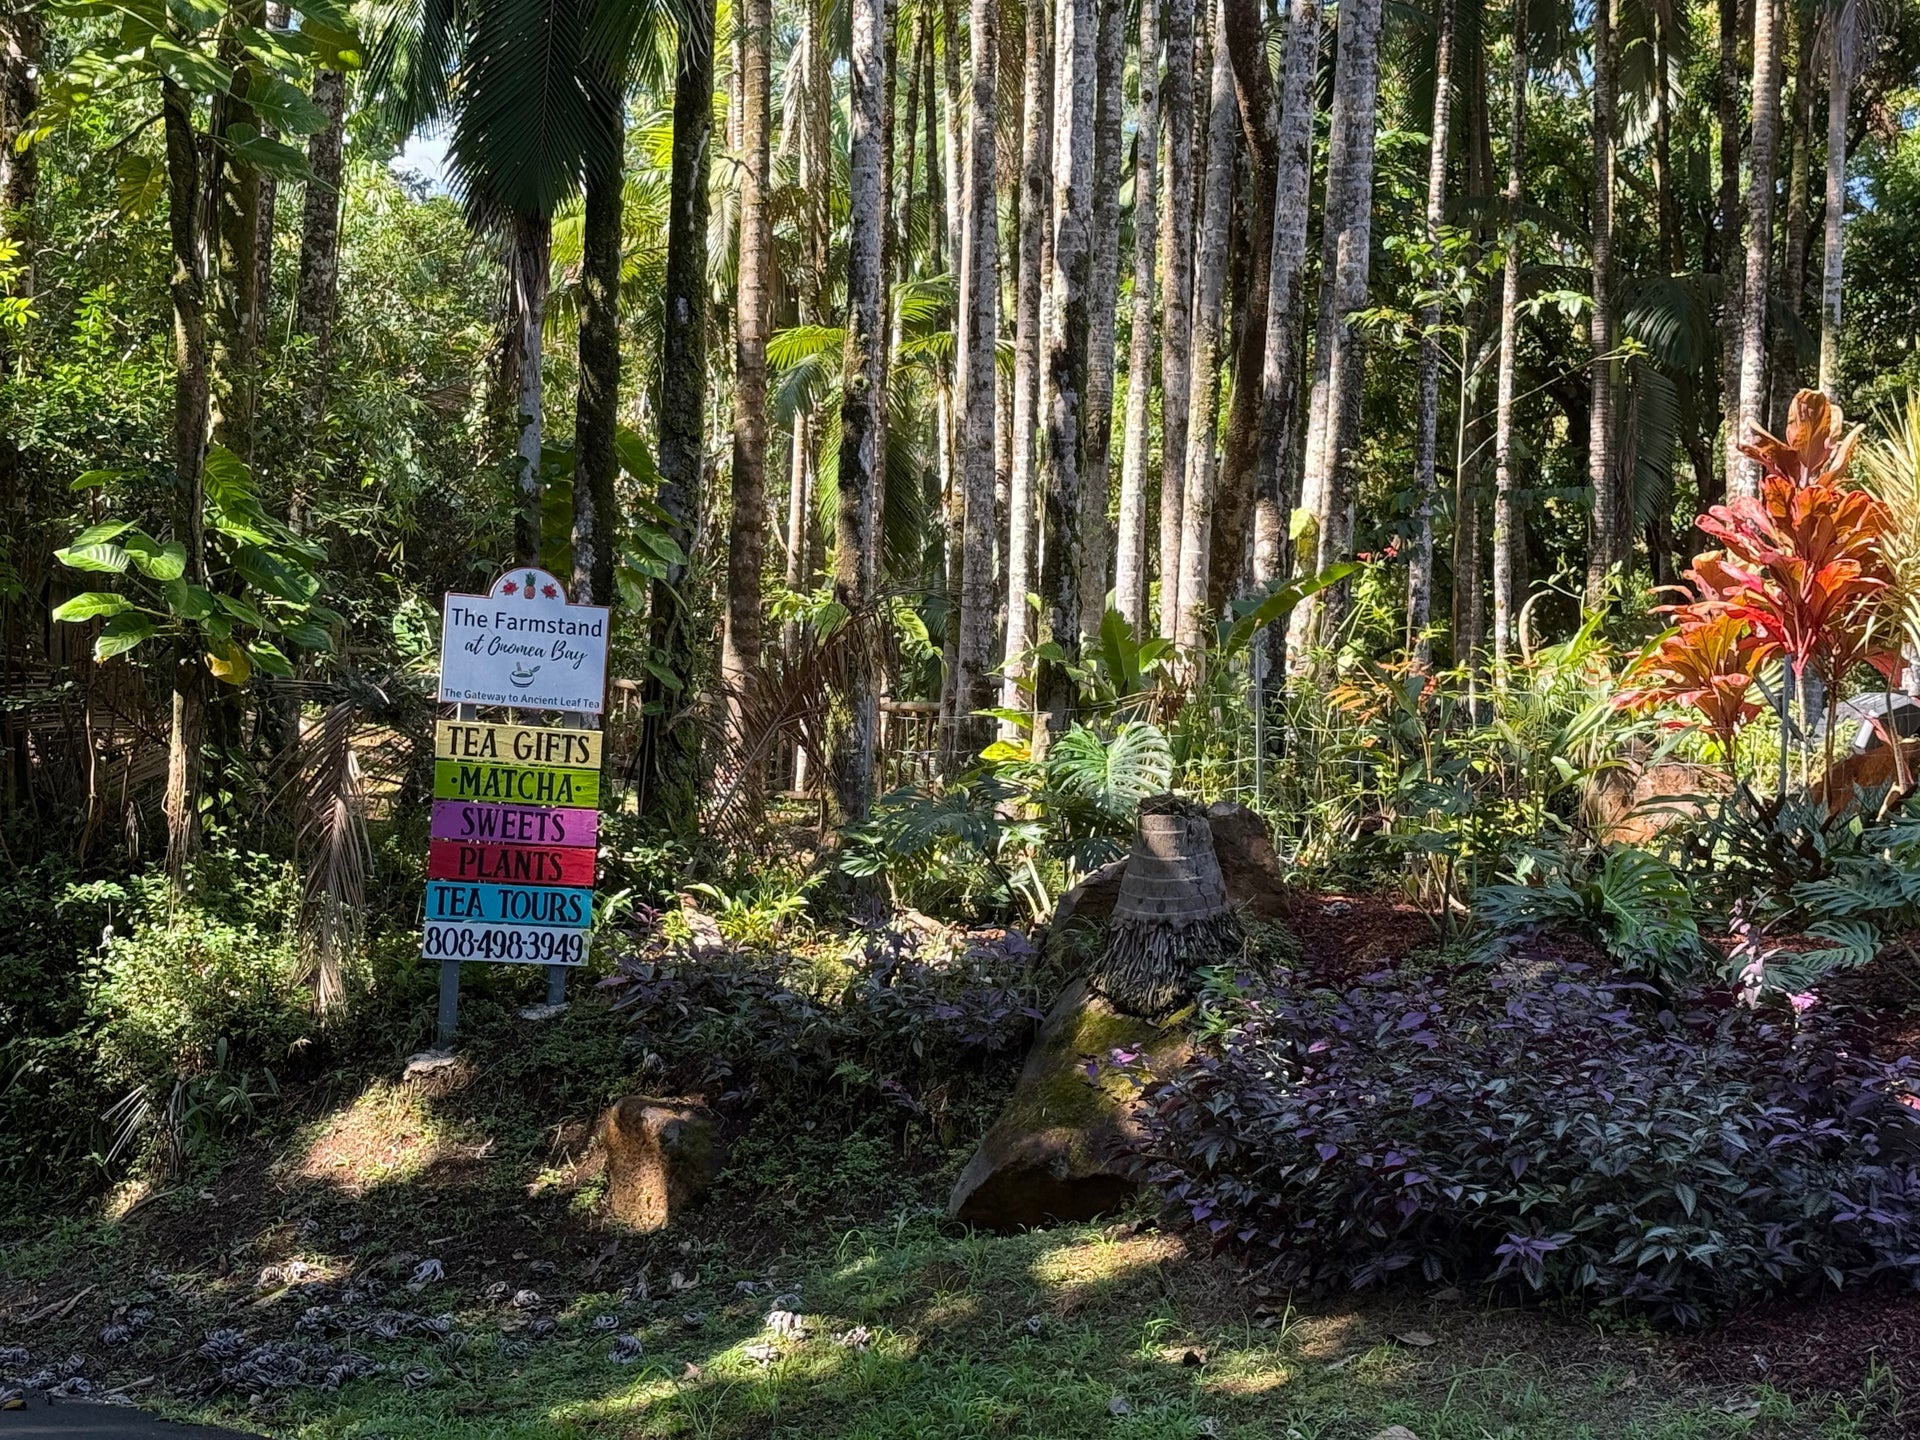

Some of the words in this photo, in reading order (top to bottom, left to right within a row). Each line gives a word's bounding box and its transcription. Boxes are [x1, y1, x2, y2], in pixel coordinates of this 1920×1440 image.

[452, 608, 488, 628] The
[495, 612, 602, 637] Farmstand
[464, 634, 485, 654] at
[550, 640, 588, 670] Bay
[444, 688, 462, 699] The
[464, 690, 506, 703] Gateway
[508, 693, 519, 703] to
[521, 694, 558, 705] Ancient
[560, 697, 581, 707] Leaf
[584, 699, 600, 709] Tea
[447, 726, 498, 757] TEA
[513, 731, 590, 764] GIFTS
[460, 807, 566, 842] SWEETS
[458, 847, 563, 881] PLANTS
[434, 886, 485, 917] TEA
[498, 889, 583, 923] TOURS
[425, 927, 584, 962] 808-498-3949
